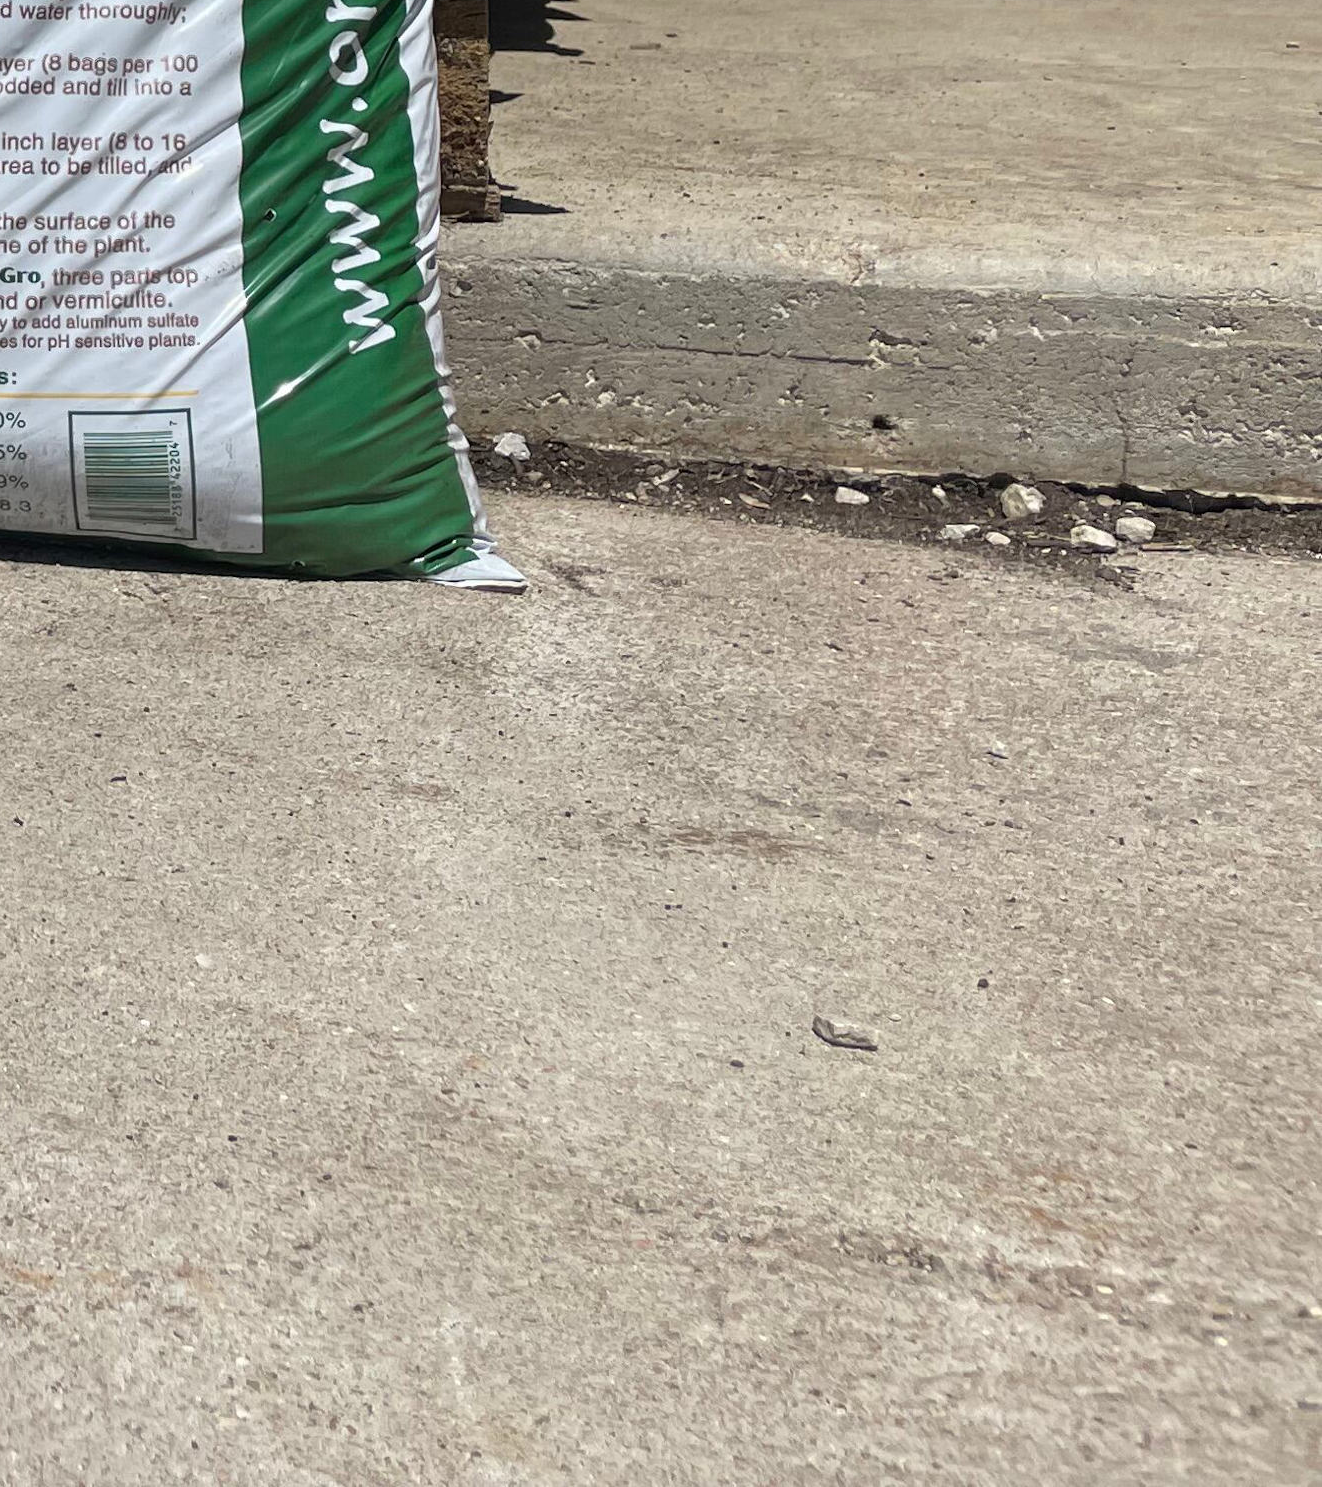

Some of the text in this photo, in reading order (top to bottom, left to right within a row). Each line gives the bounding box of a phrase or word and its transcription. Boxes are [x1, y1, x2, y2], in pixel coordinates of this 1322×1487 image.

[42, 53, 61, 73] (8
[67, 53, 117, 77] bags
[122, 57, 154, 76] per
[162, 55, 198, 72] 100
